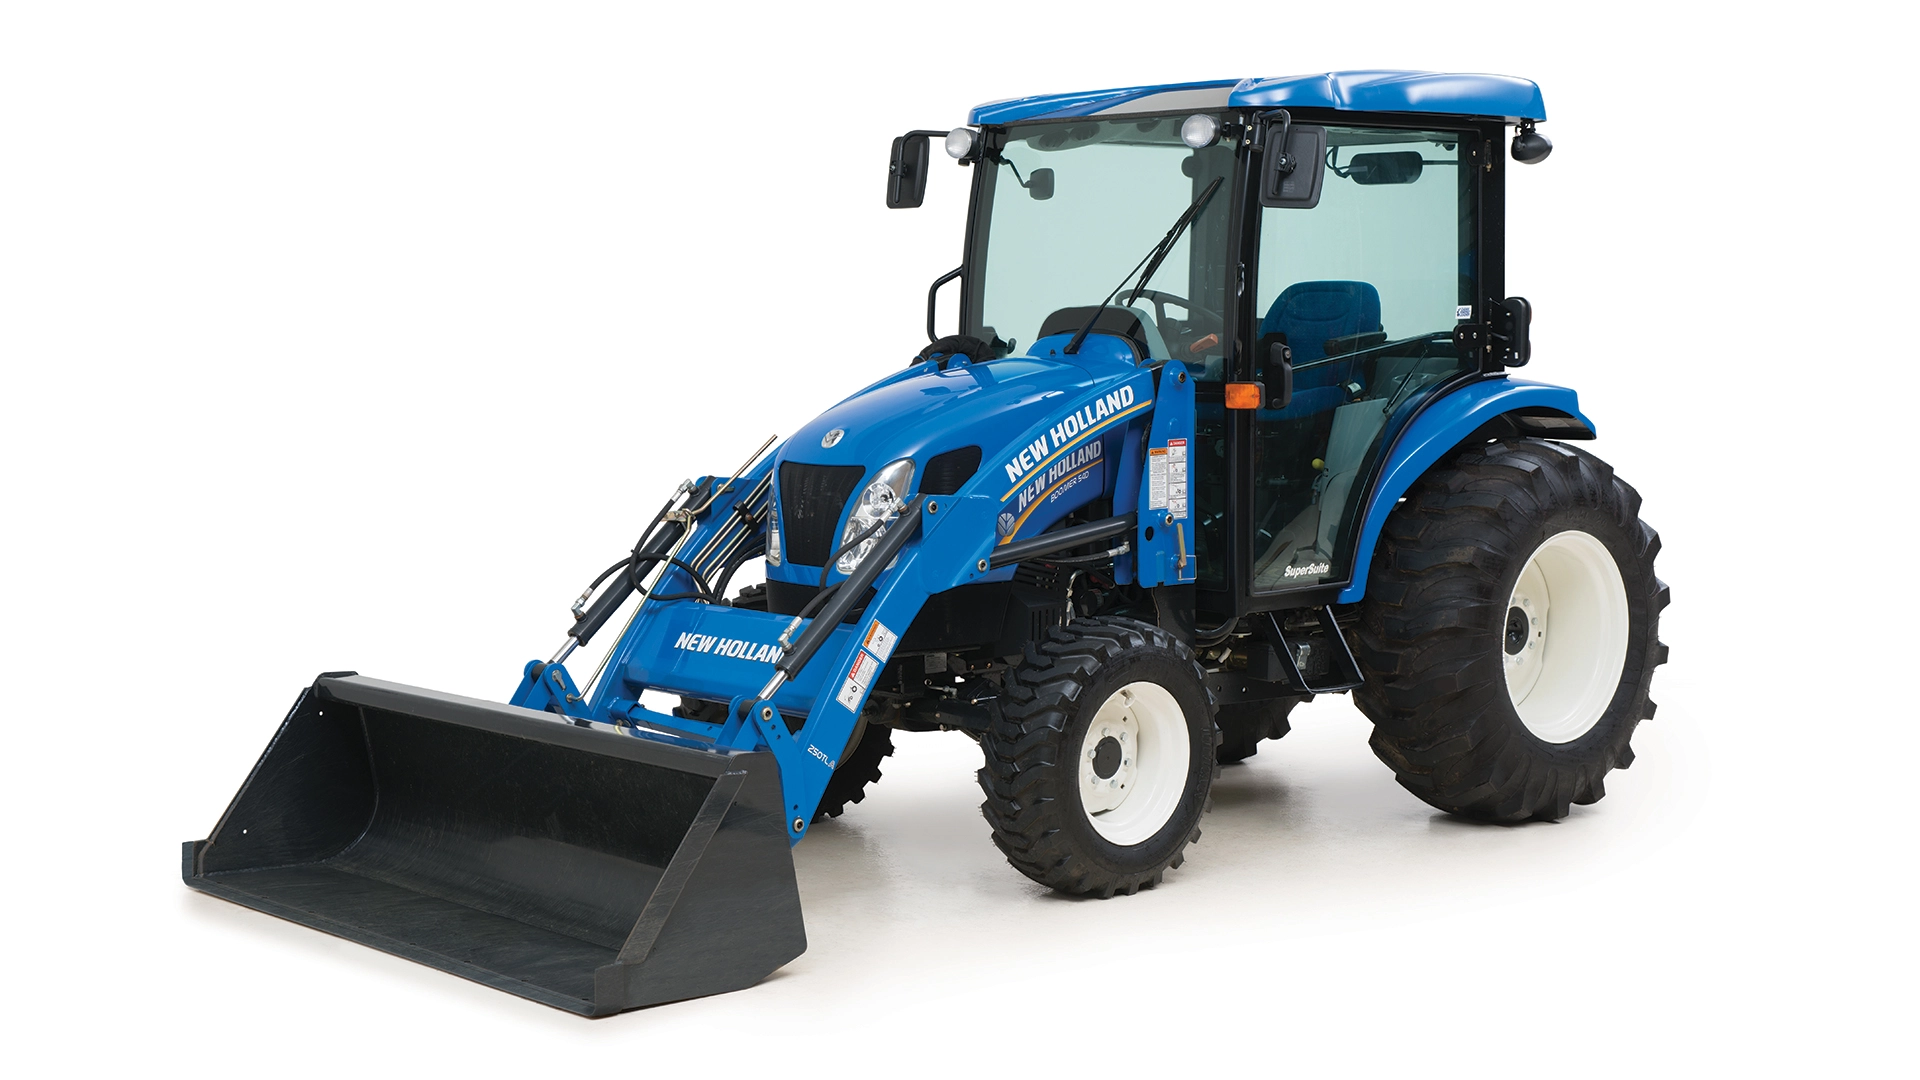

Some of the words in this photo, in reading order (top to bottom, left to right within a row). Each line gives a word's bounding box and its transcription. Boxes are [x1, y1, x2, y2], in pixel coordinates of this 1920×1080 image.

[1005, 434, 1049, 483] NEW
[1050, 385, 1134, 448] HOLLAND
[1018, 473, 1046, 513] NEW
[1048, 440, 1102, 484] HOLLAND
[1050, 477, 1077, 503] BOOMER
[1284, 562, 1329, 579] SuperSuite
[674, 631, 718, 654] NEW
[807, 743, 836, 770] 250TLA
